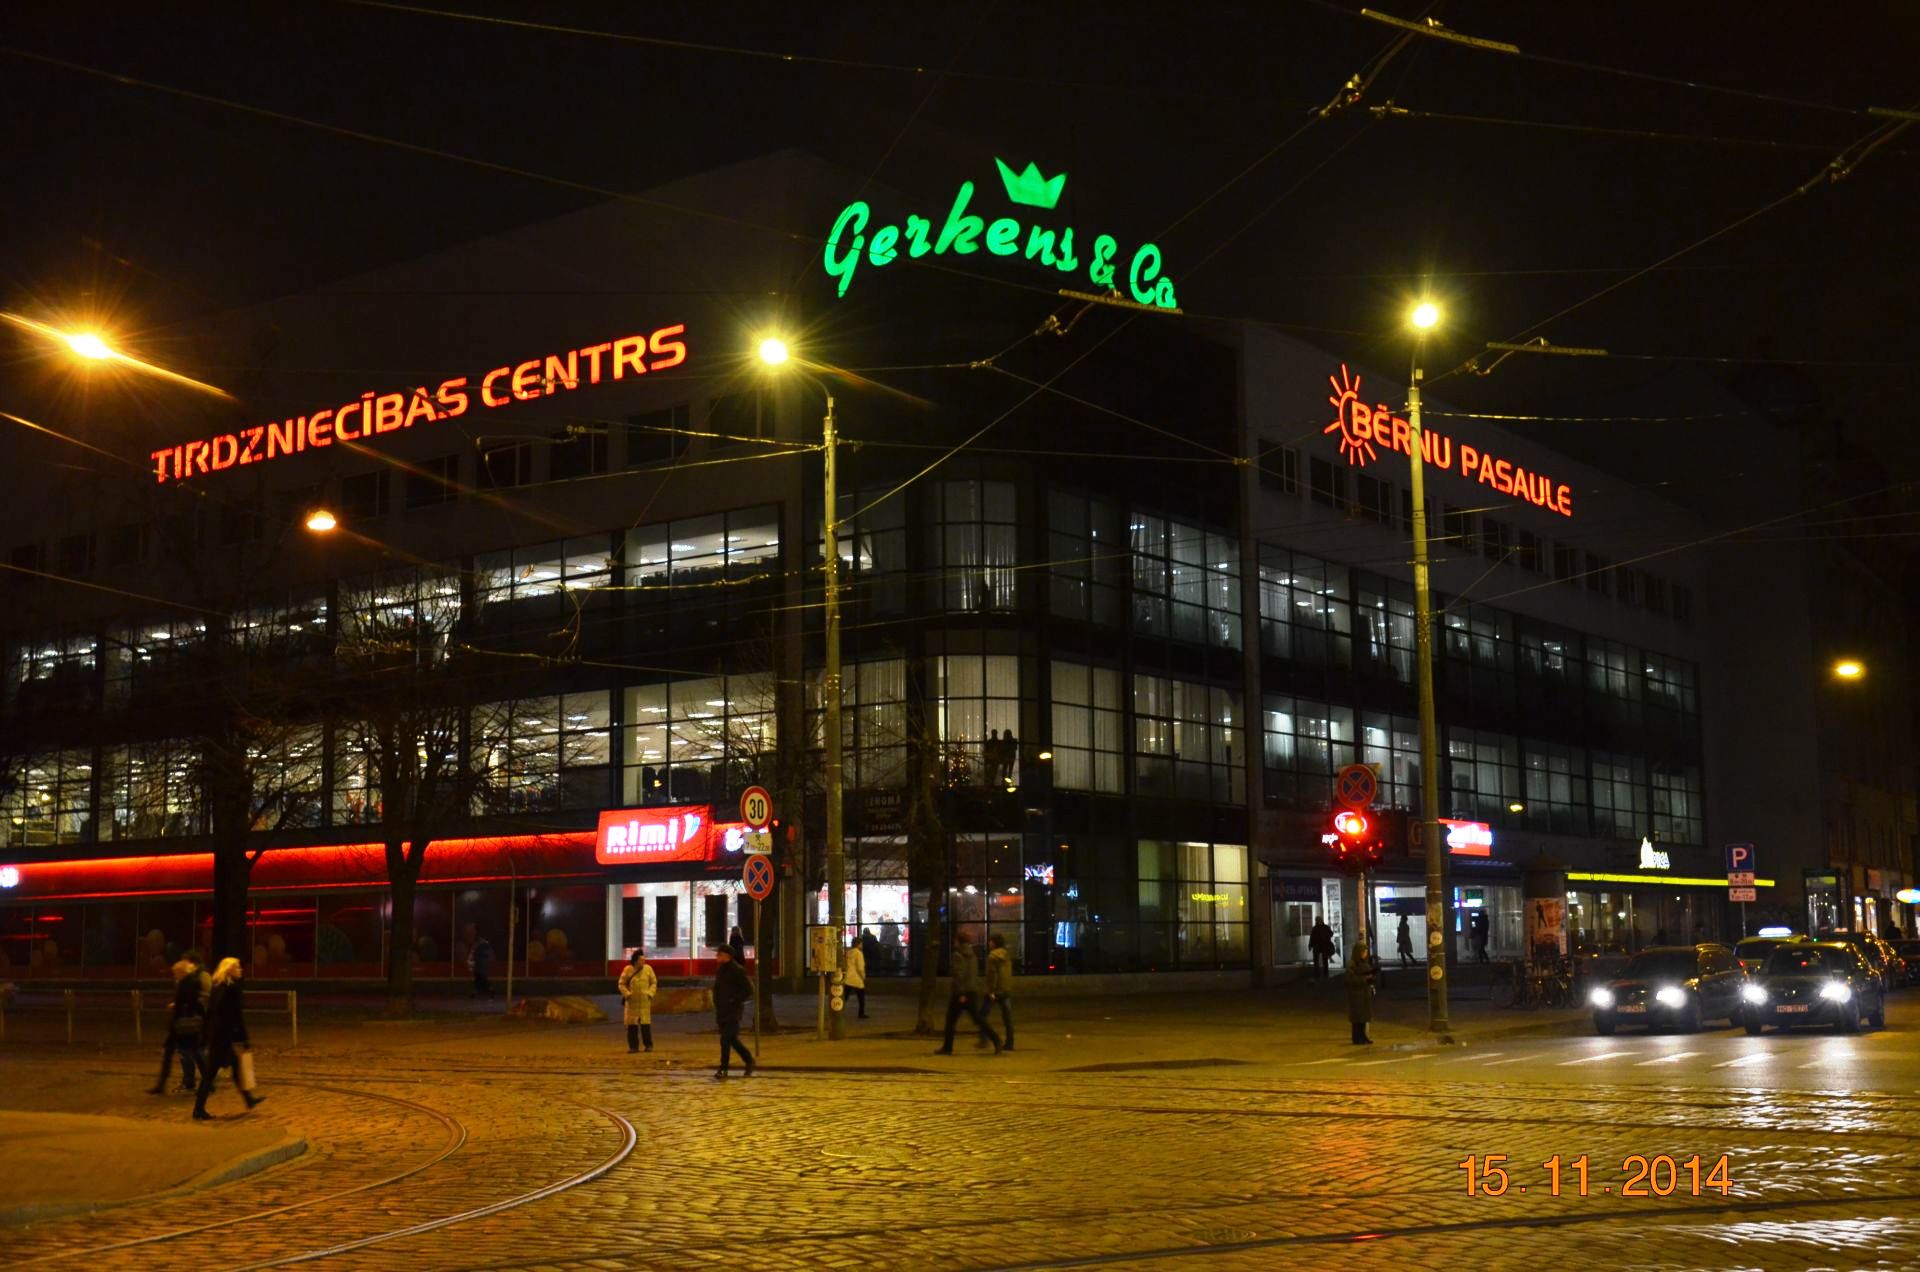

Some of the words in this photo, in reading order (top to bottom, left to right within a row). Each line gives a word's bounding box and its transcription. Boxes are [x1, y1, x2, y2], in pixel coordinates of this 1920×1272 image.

[824, 180, 1079, 298] Gerkens
[1089, 235, 1118, 289] &
[151, 377, 468, 483] TIRDZNIECĪBAS
[481, 323, 687, 408] CENTRS
[1351, 400, 1451, 470] BĒRNU
[1461, 444, 1572, 517] PASAULE
[749, 799, 764, 820] 30
[1732, 847, 1747, 868] P
